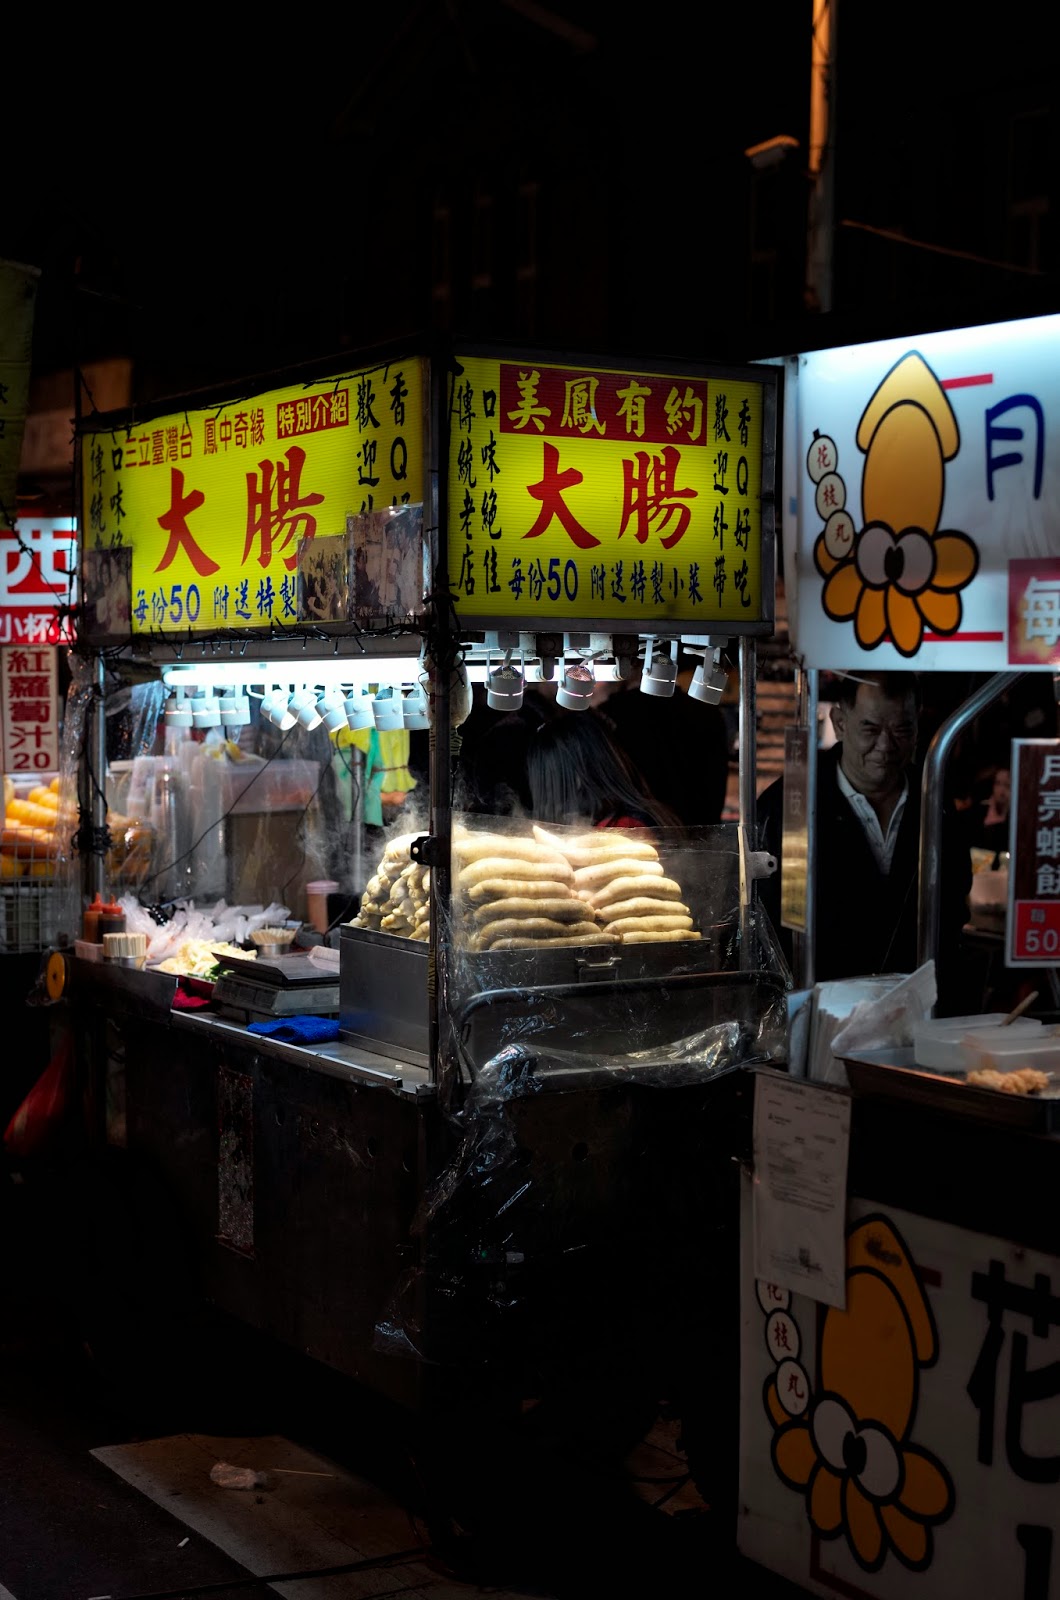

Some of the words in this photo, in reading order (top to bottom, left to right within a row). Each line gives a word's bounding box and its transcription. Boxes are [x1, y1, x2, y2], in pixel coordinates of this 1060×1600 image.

[124, 423, 193, 469] 三立臺灣台
[203, 407, 265, 456] 鳳中奇緣
[278, 391, 347, 437] 特別介紹
[389, 371, 410, 505] 香Q
[507, 369, 704, 441] 美鳳有約
[985, 393, 1045, 501] 月
[90, 445, 105, 550] 傳統
[153, 445, 325, 578] 大腸
[457, 379, 477, 595] 傳統老店
[481, 389, 501, 594] 口味絕佳
[520, 441, 698, 550] 大腸
[713, 393, 731, 609] 歡迎外帶
[734, 398, 751, 608] 香Q好吃
[816, 444, 850, 544] 花枝丸
[133, 584, 201, 626] 每份50
[213, 574, 298, 620] 附送特製
[508, 558, 578, 602] 每份50
[590, 559, 704, 606] 附送特製小菜
[7, 651, 52, 750] 紅蘿蔔汁
[13, 752, 51, 770] 20
[1025, 929, 1059, 953] 50
[967, 1259, 1060, 1484] 花
